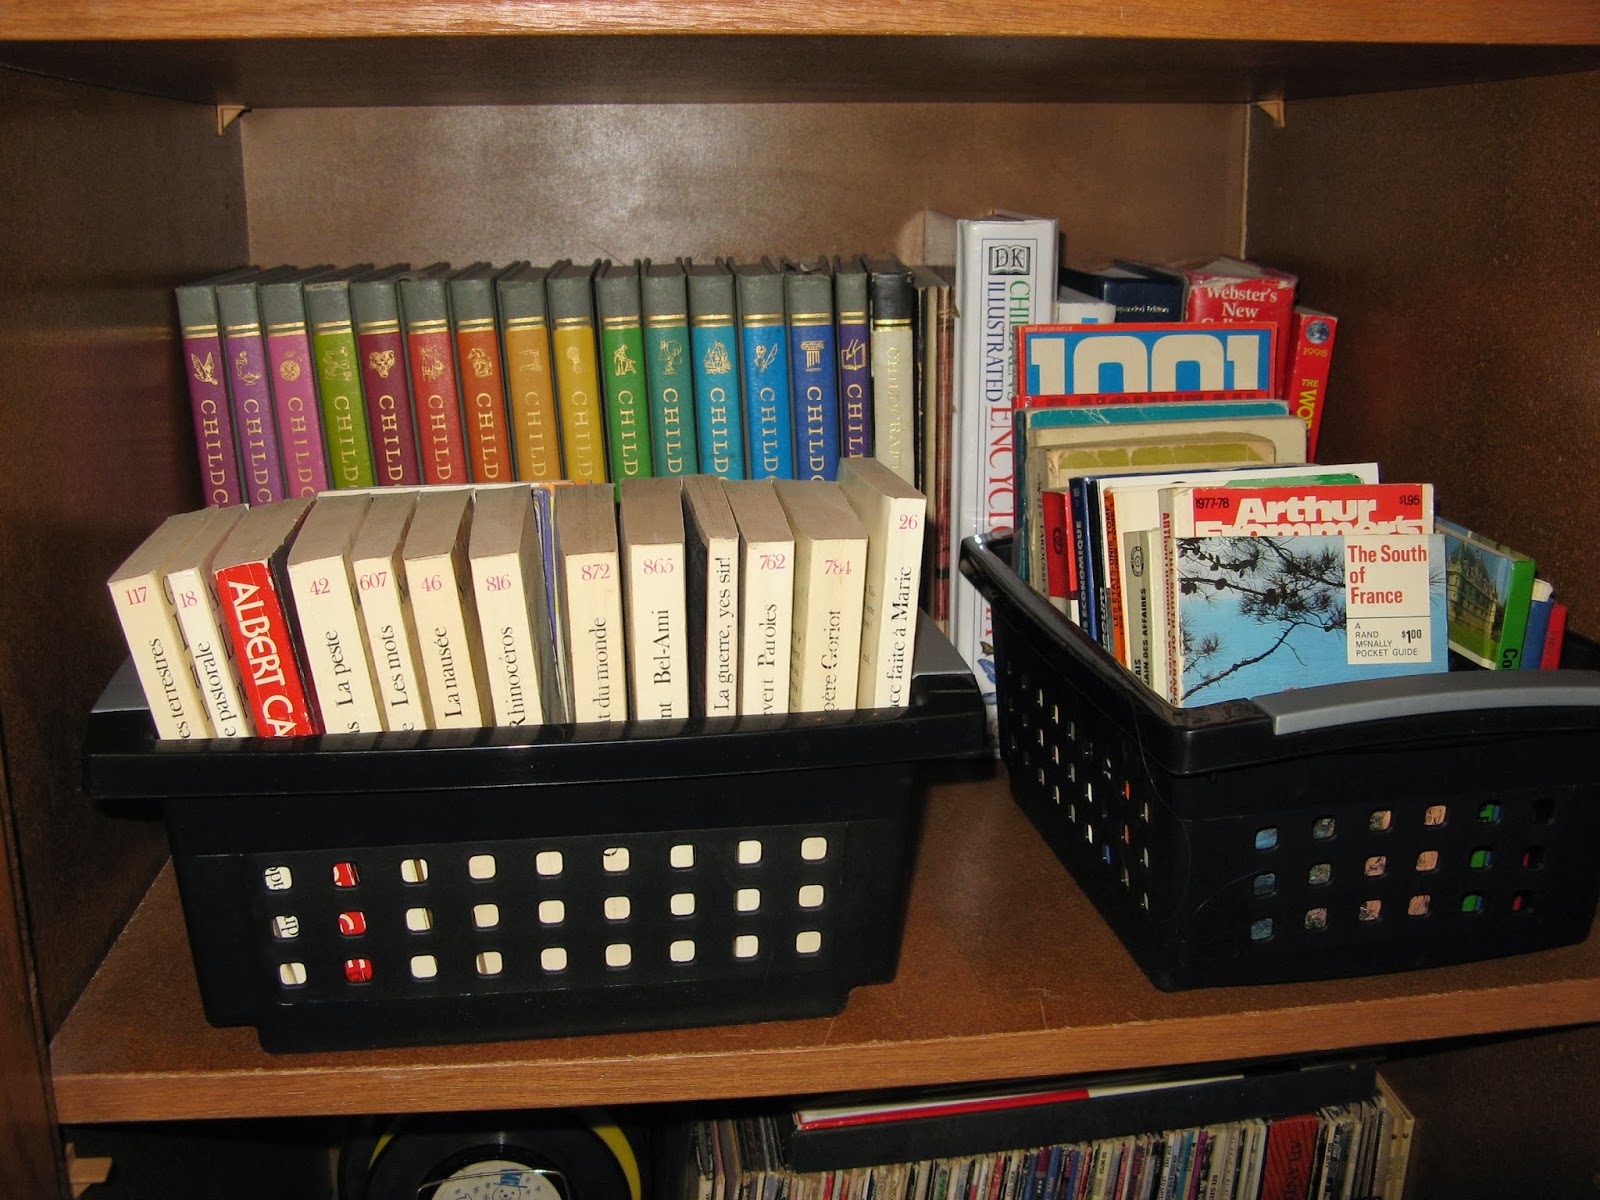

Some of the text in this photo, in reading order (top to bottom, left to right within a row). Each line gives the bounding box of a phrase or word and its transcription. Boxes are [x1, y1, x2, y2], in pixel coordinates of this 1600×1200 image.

[994, 248, 1025, 270] DK
[1207, 285, 1278, 303] Webster's
[1222, 302, 1259, 319] New
[985, 281, 1006, 403] ILLUSTRATED
[1303, 347, 1328, 358] 1998
[1031, 334, 1260, 395] 1001
[1301, 378, 1319, 388] THE
[333, 395, 359, 488] CHILD
[475, 392, 499, 479] CHILD
[523, 391, 547, 477] CHILD
[571, 391, 593, 478] CHILD
[617, 390, 640, 476] CHILD
[662, 387, 684, 474] CHILD
[709, 387, 730, 480] CHILD
[759, 387, 779, 480] CHILD
[1195, 497, 1230, 509] 1977-78
[1234, 496, 1377, 524] Arthur
[898, 514, 918, 530] 26
[643, 557, 674, 575] 865
[759, 554, 786, 570] 762
[824, 559, 852, 575] 784
[1347, 543, 1427, 563] The South
[359, 571, 388, 591] 607
[421, 574, 442, 592] 46
[486, 574, 511, 592] 816
[581, 563, 610, 582] 872
[1075, 520, 1088, 619] ECONOMIQUE
[1350, 566, 1365, 583] of
[124, 586, 148, 606] 117
[179, 590, 198, 608] 18
[310, 577, 331, 596] 42
[891, 566, 912, 622] Marie
[1350, 587, 1403, 604] France
[1139, 588, 1148, 636] AFFAIRES
[1355, 622, 1361, 630] A
[228, 581, 286, 686] ALBERT
[381, 624, 402, 671] mots
[652, 608, 672, 686] Bel-Ami
[714, 557, 735, 711] La guerre, yes sir!
[757, 603, 777, 667] Paroles
[325, 630, 352, 675] peste
[588, 616, 610, 681] monde
[886, 644, 905, 680] faite
[1141, 638, 1149, 659] DES
[1356, 648, 1418, 657] POCKET GUIDE
[1501, 648, 1518, 668] Co
[149, 638, 185, 719] terrestres
[195, 640, 238, 722] pastorale
[433, 626, 463, 718] La nausée
[499, 626, 526, 727] Rhinocéros
[335, 681, 354, 708] La
[391, 674, 409, 708] Les
[592, 681, 610, 708] du
